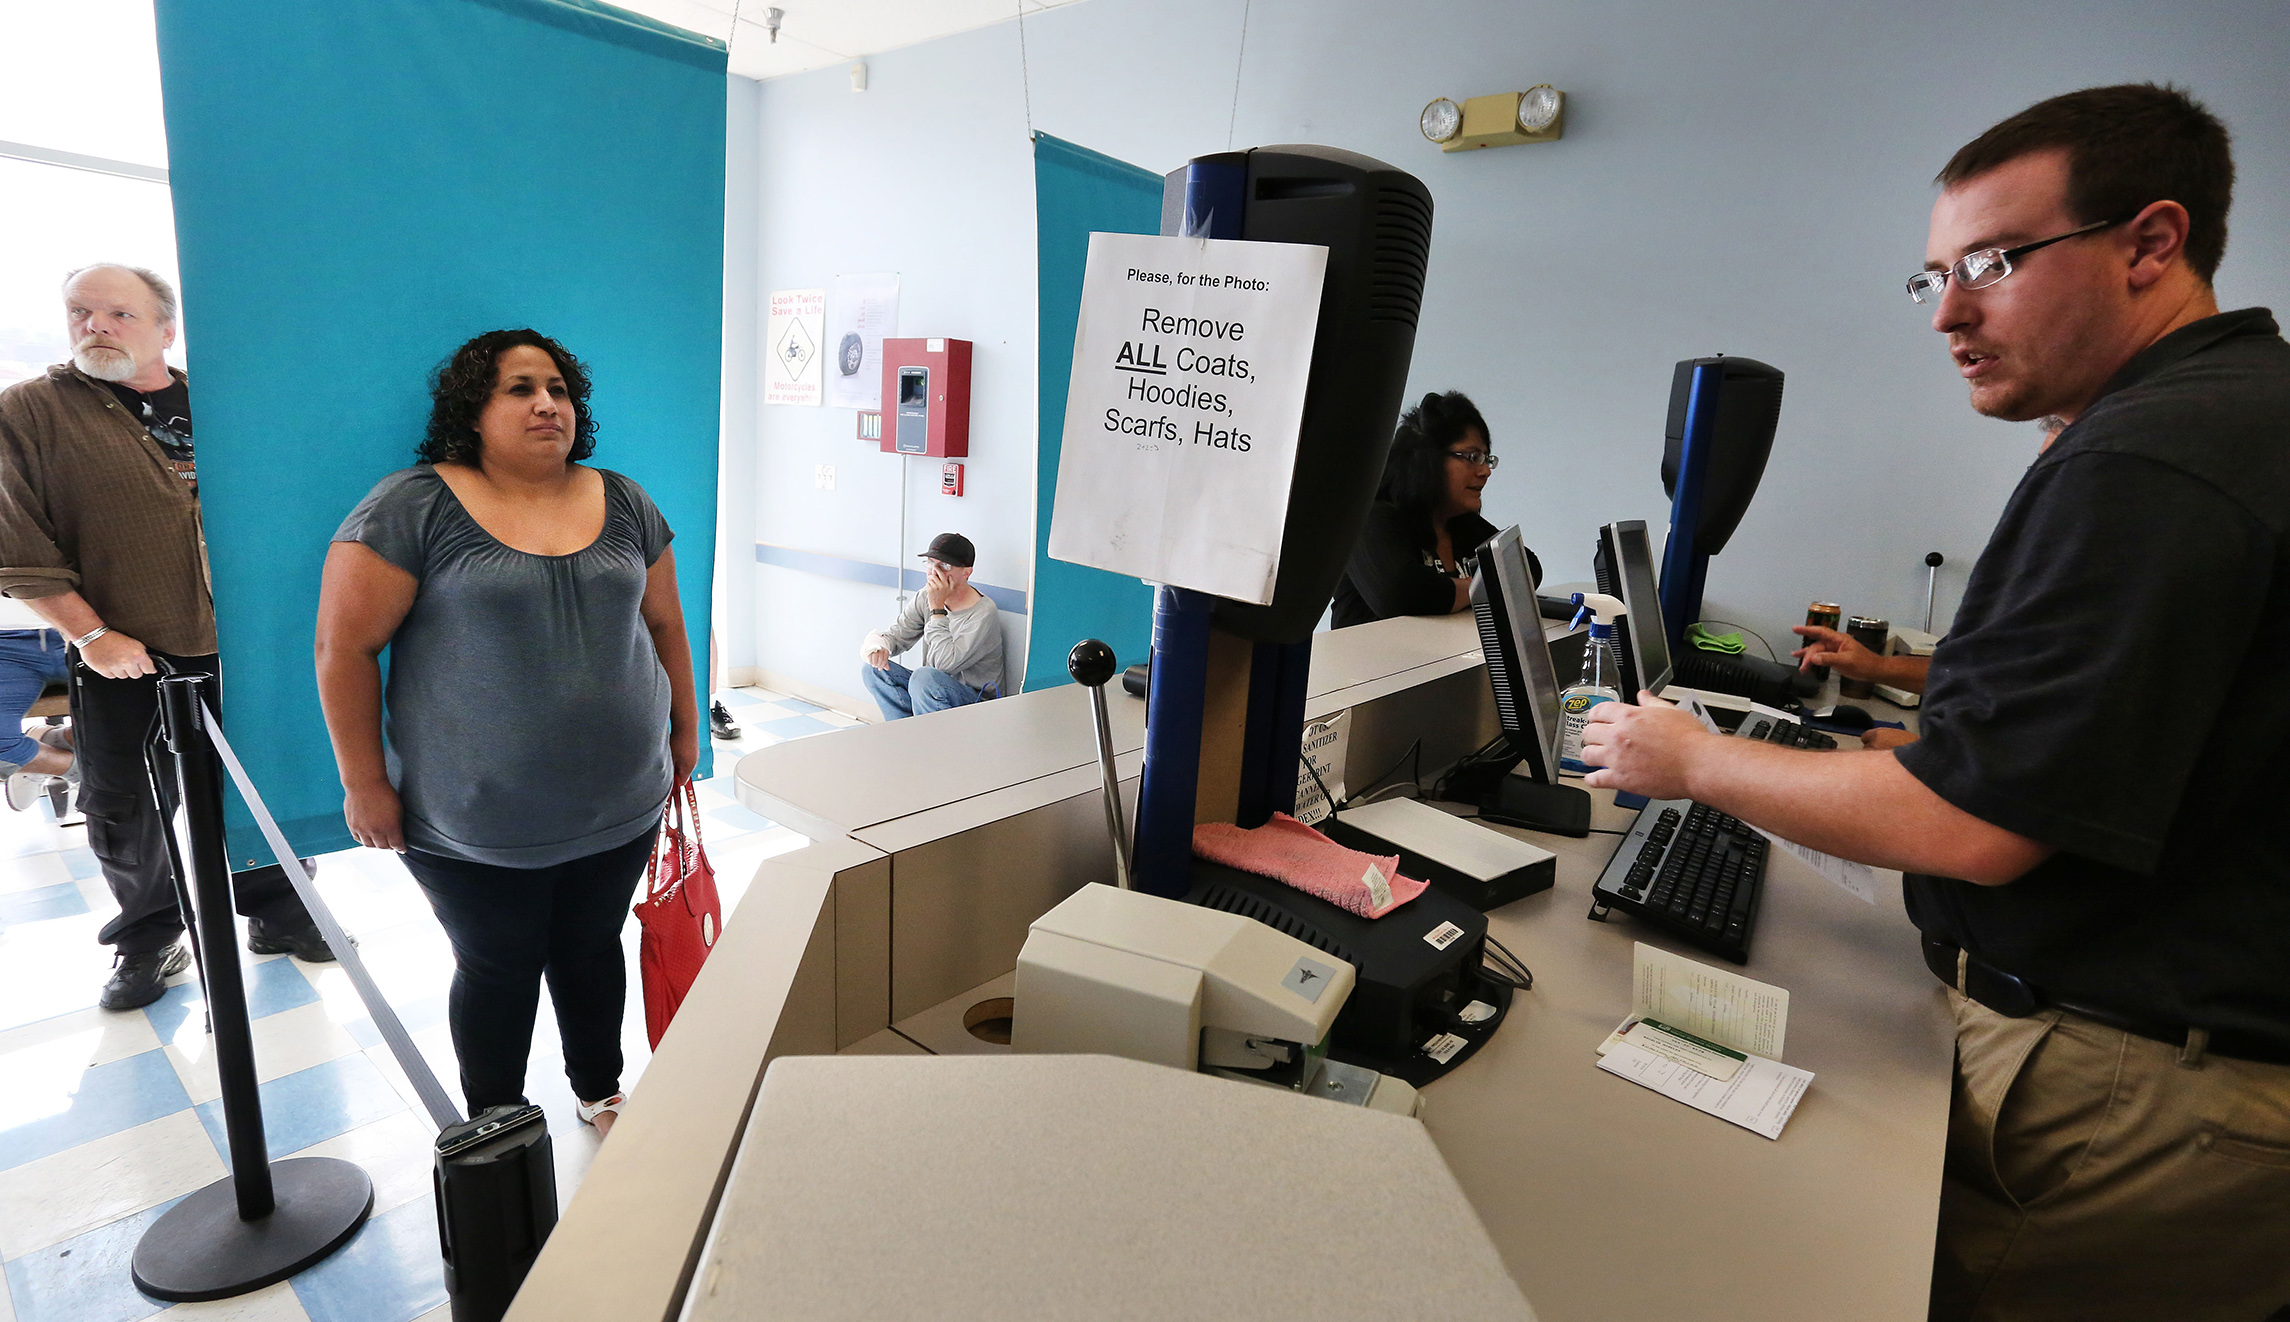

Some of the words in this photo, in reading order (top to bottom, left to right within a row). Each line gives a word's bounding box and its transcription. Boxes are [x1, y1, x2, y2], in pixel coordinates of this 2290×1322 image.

[1127, 268, 1173, 286] Please,
[1177, 272, 1196, 286] for
[1199, 273, 1220, 288] the
[1224, 275, 1270, 292] Photo:
[771, 306, 793, 316] Save
[796, 307, 802, 315] a
[805, 305, 822, 315] Life
[772, 295, 794, 305] Look
[796, 294, 823, 304] Twice
[1142, 307, 1245, 342] Remove
[1115, 341, 1167, 371] ALL
[1176, 347, 1256, 384] Coats,
[768, 393, 780, 401] are
[773, 381, 816, 392] Motorcycles
[1127, 376, 1233, 418] Hoodies,
[1104, 408, 1184, 446] Scarfs,
[1194, 421, 1252, 453] Hats
[1566, 721, 1579, 729] lass
[1302, 731, 1338, 754] SANITIZER
[1296, 762, 1332, 786] GERRINT
[1297, 807, 1323, 824] DEX!!!
